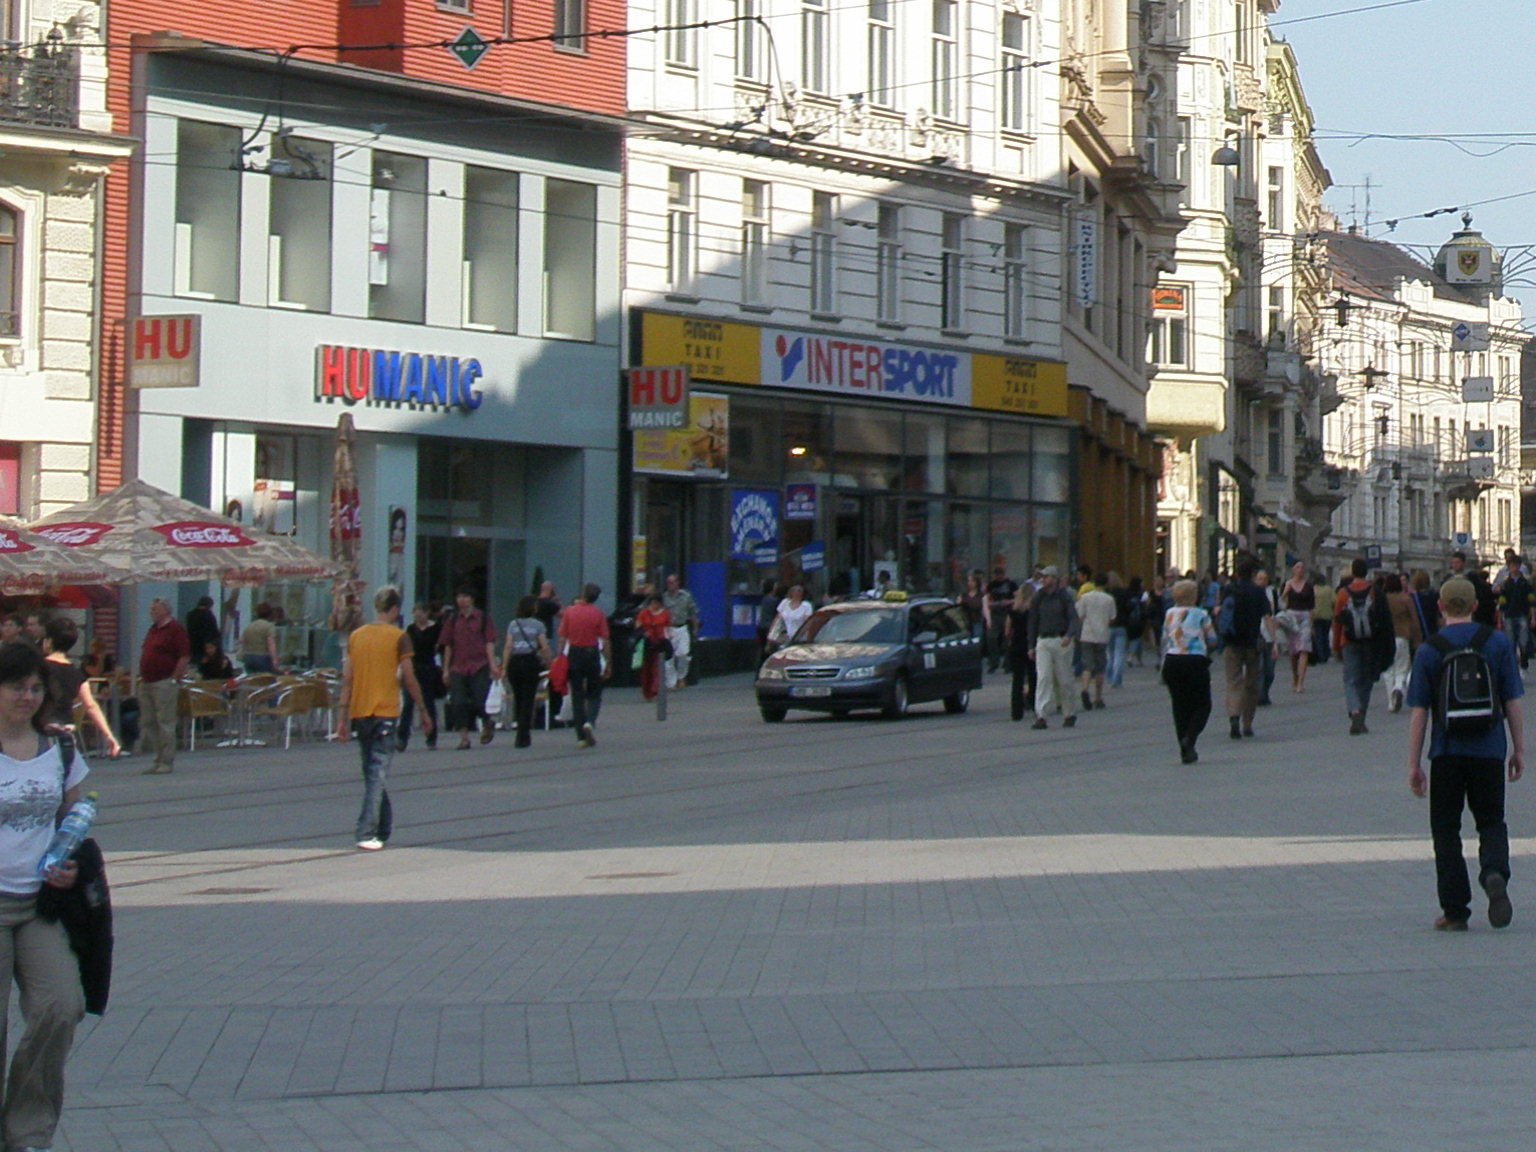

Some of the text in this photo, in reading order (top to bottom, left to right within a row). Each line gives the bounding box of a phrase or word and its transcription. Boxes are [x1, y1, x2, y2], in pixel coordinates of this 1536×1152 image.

[134, 318, 192, 360] HU
[685, 343, 721, 360] TAXI
[314, 344, 483, 410] HUMANIC
[806, 337, 959, 398] INTERSPORT
[631, 368, 683, 406] HU
[1006, 379, 1036, 396] TAXI
[630, 410, 683, 428] MANIC
[172, 526, 240, 544] Coca-Cola
